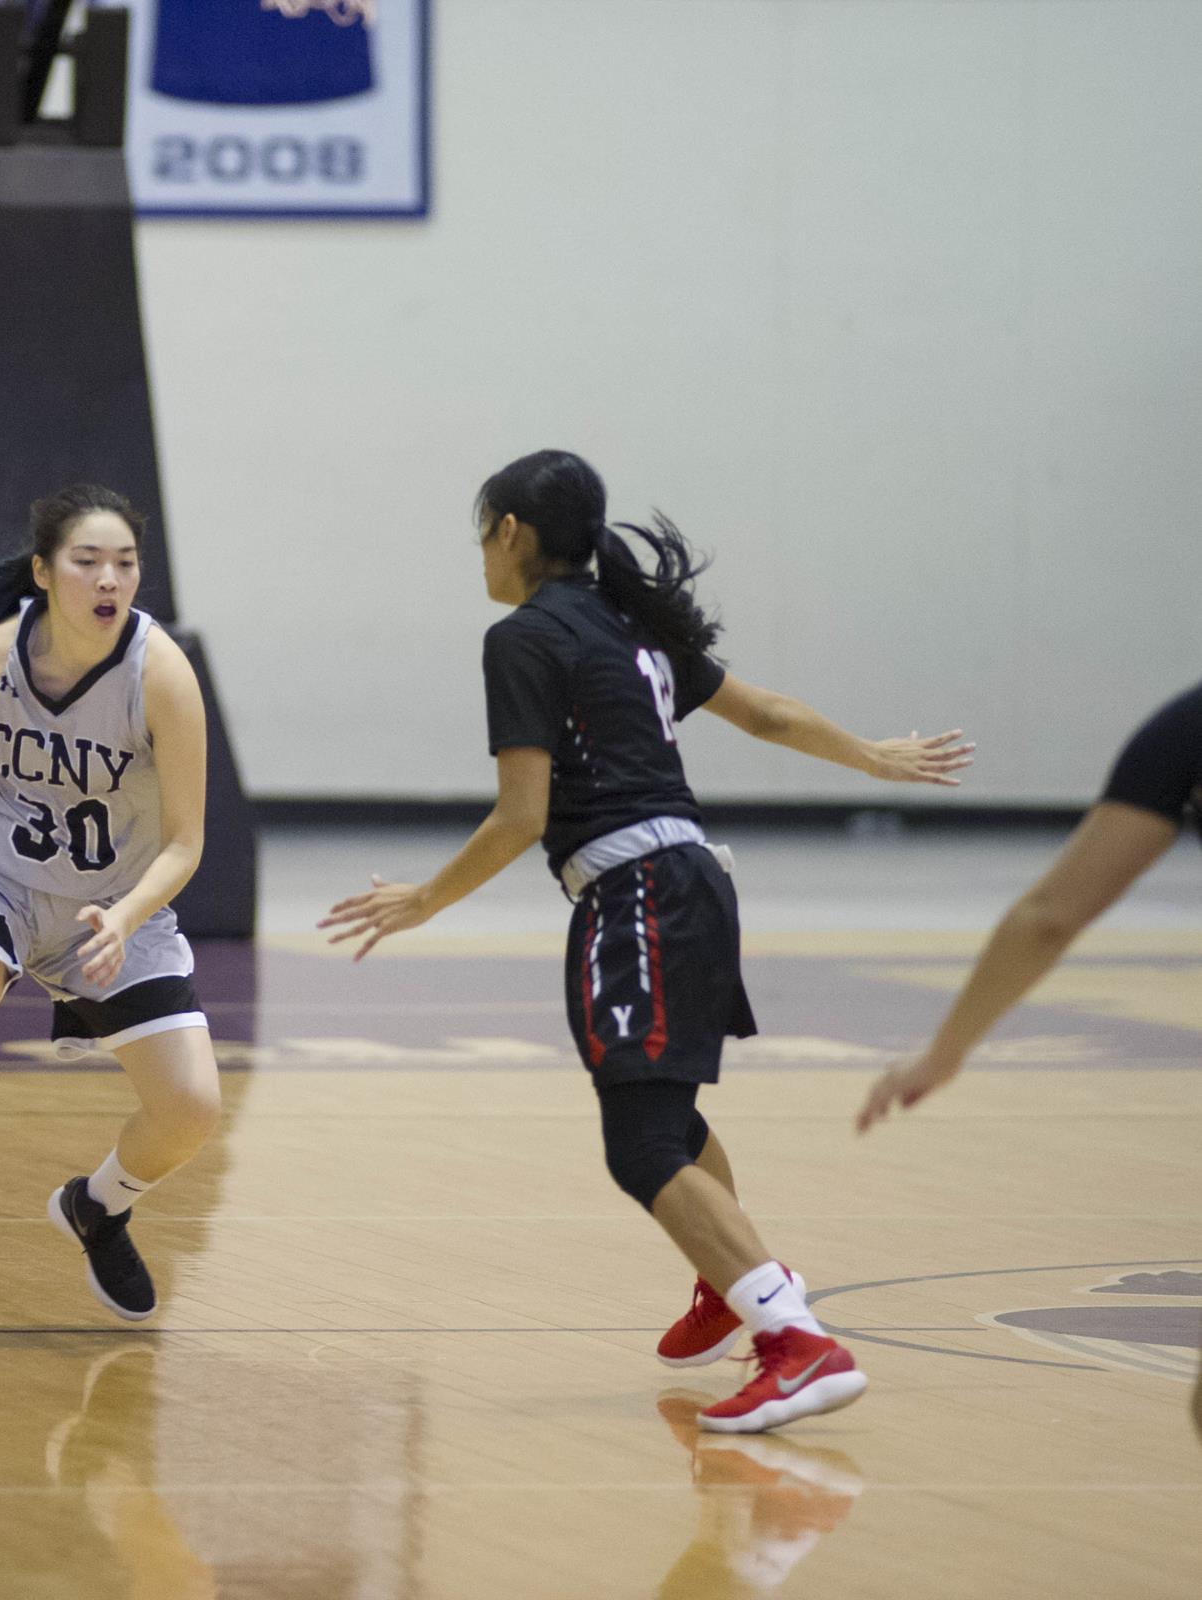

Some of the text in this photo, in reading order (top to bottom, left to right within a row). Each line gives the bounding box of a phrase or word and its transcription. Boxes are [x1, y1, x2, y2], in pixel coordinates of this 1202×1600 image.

[152, 134, 367, 184] 2008
[10, 794, 117, 872] 30
[611, 1005, 633, 1037] Y
